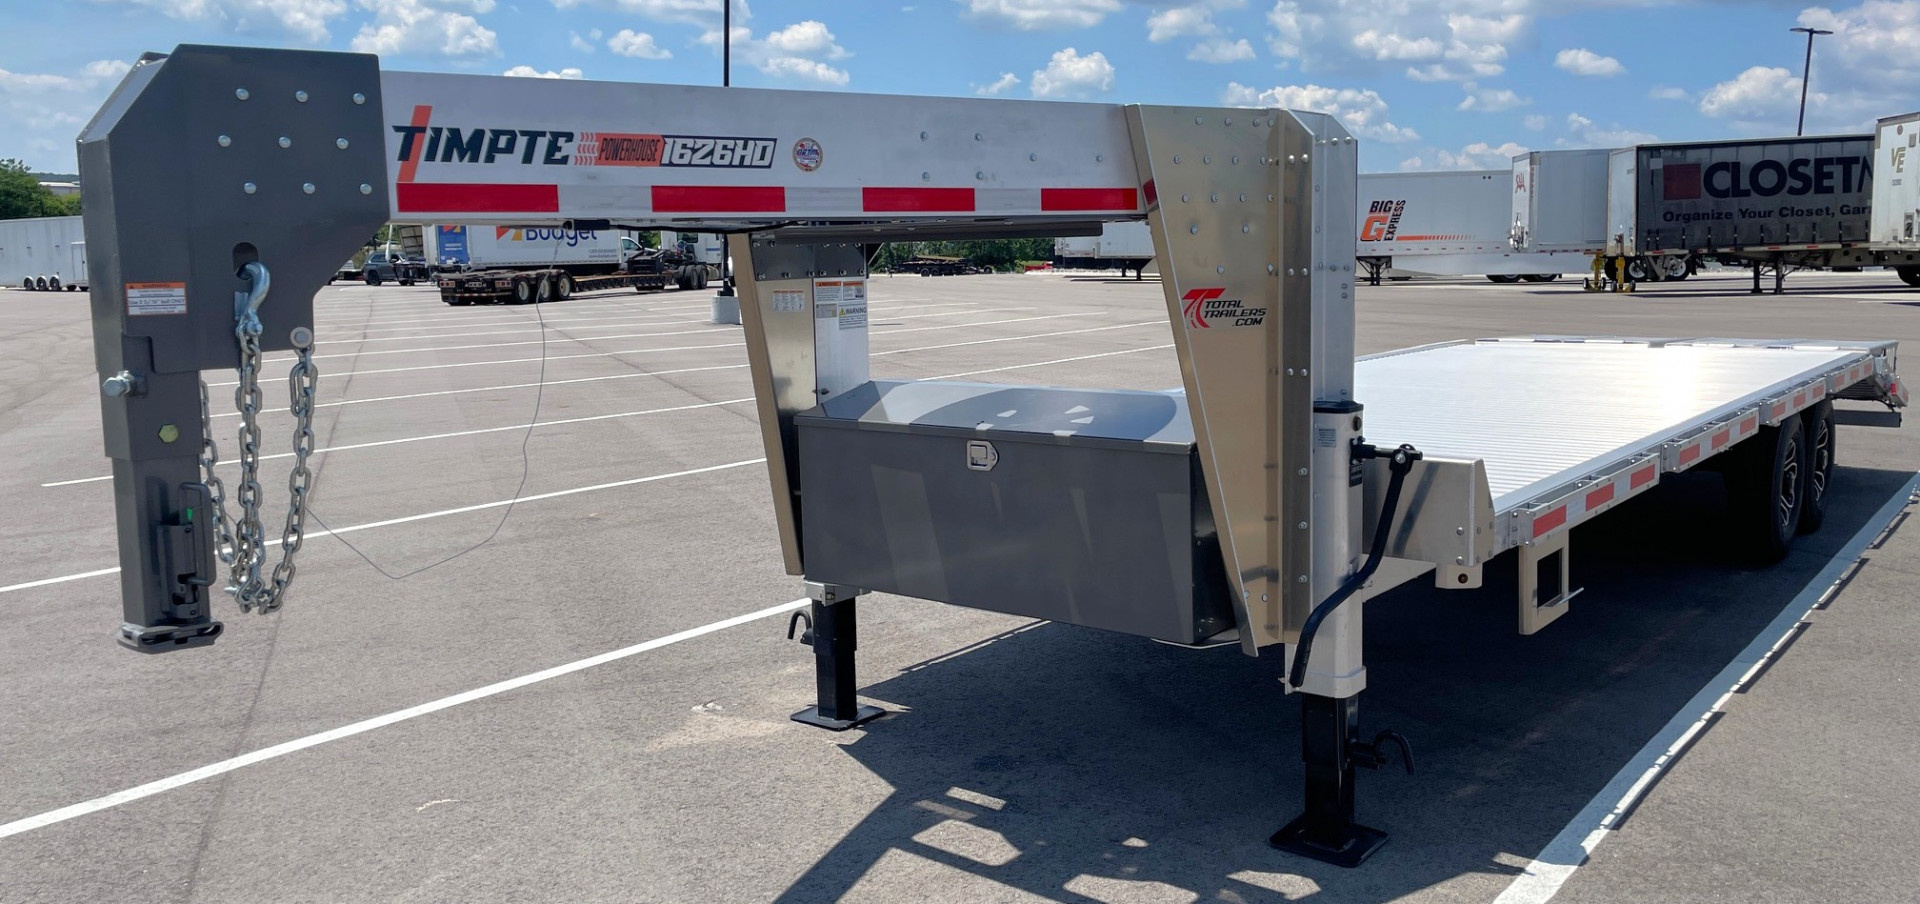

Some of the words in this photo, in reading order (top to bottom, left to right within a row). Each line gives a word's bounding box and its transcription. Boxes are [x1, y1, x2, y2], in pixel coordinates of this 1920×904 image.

[392, 123, 575, 167] TIMPTE
[599, 136, 661, 163] POWERHOUSE
[661, 137, 775, 167] 1626HD
[1369, 200, 1394, 213] BIG
[1662, 209, 1734, 224] Organize
[1738, 207, 1774, 219] Your
[1778, 205, 1835, 218] Closet,
[1360, 215, 1389, 241] G
[1384, 200, 1406, 241] EXPRESS
[1203, 308, 1267, 319] TRAILERS
[1205, 299, 1245, 309] TOTAL
[1232, 317, 1263, 327] .COM
